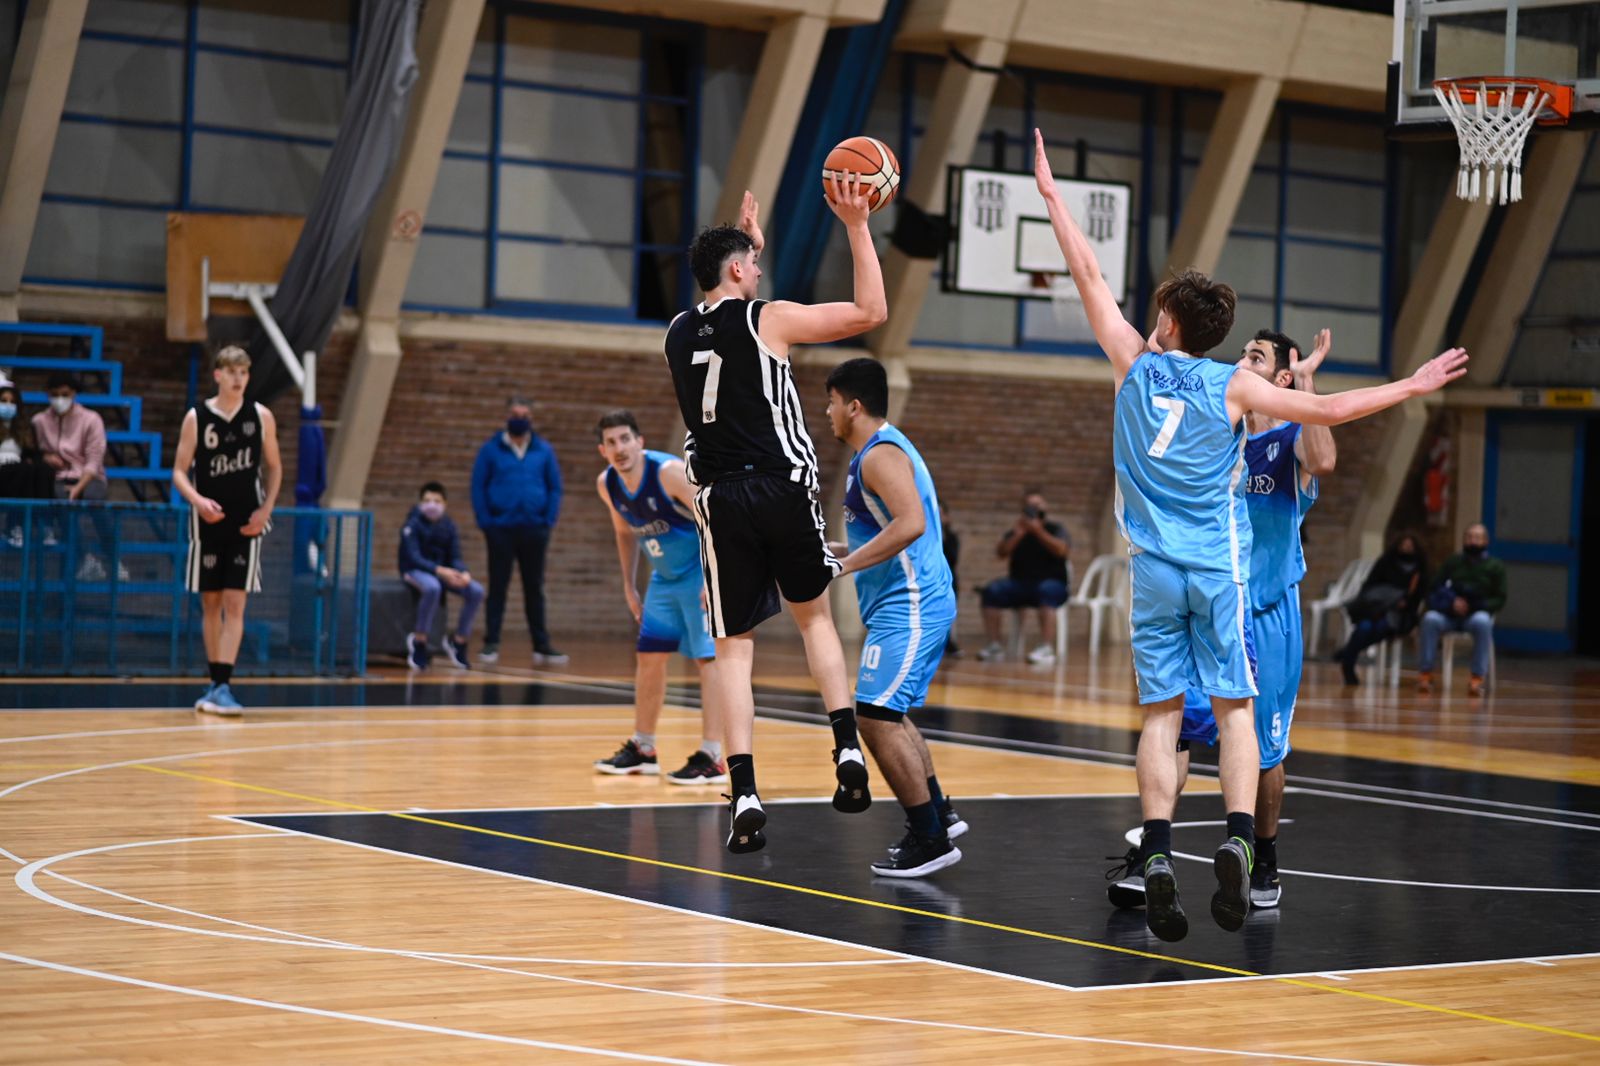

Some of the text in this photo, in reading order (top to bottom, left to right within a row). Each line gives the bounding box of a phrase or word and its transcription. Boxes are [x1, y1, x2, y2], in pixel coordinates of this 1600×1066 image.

[691, 349, 723, 424] 7
[204, 422, 219, 450] 6
[1147, 395, 1185, 459] 7
[210, 446, 253, 478] Bell
[645, 538, 664, 557] 12
[860, 644, 882, 670] 10
[1271, 711, 1281, 737] 5
